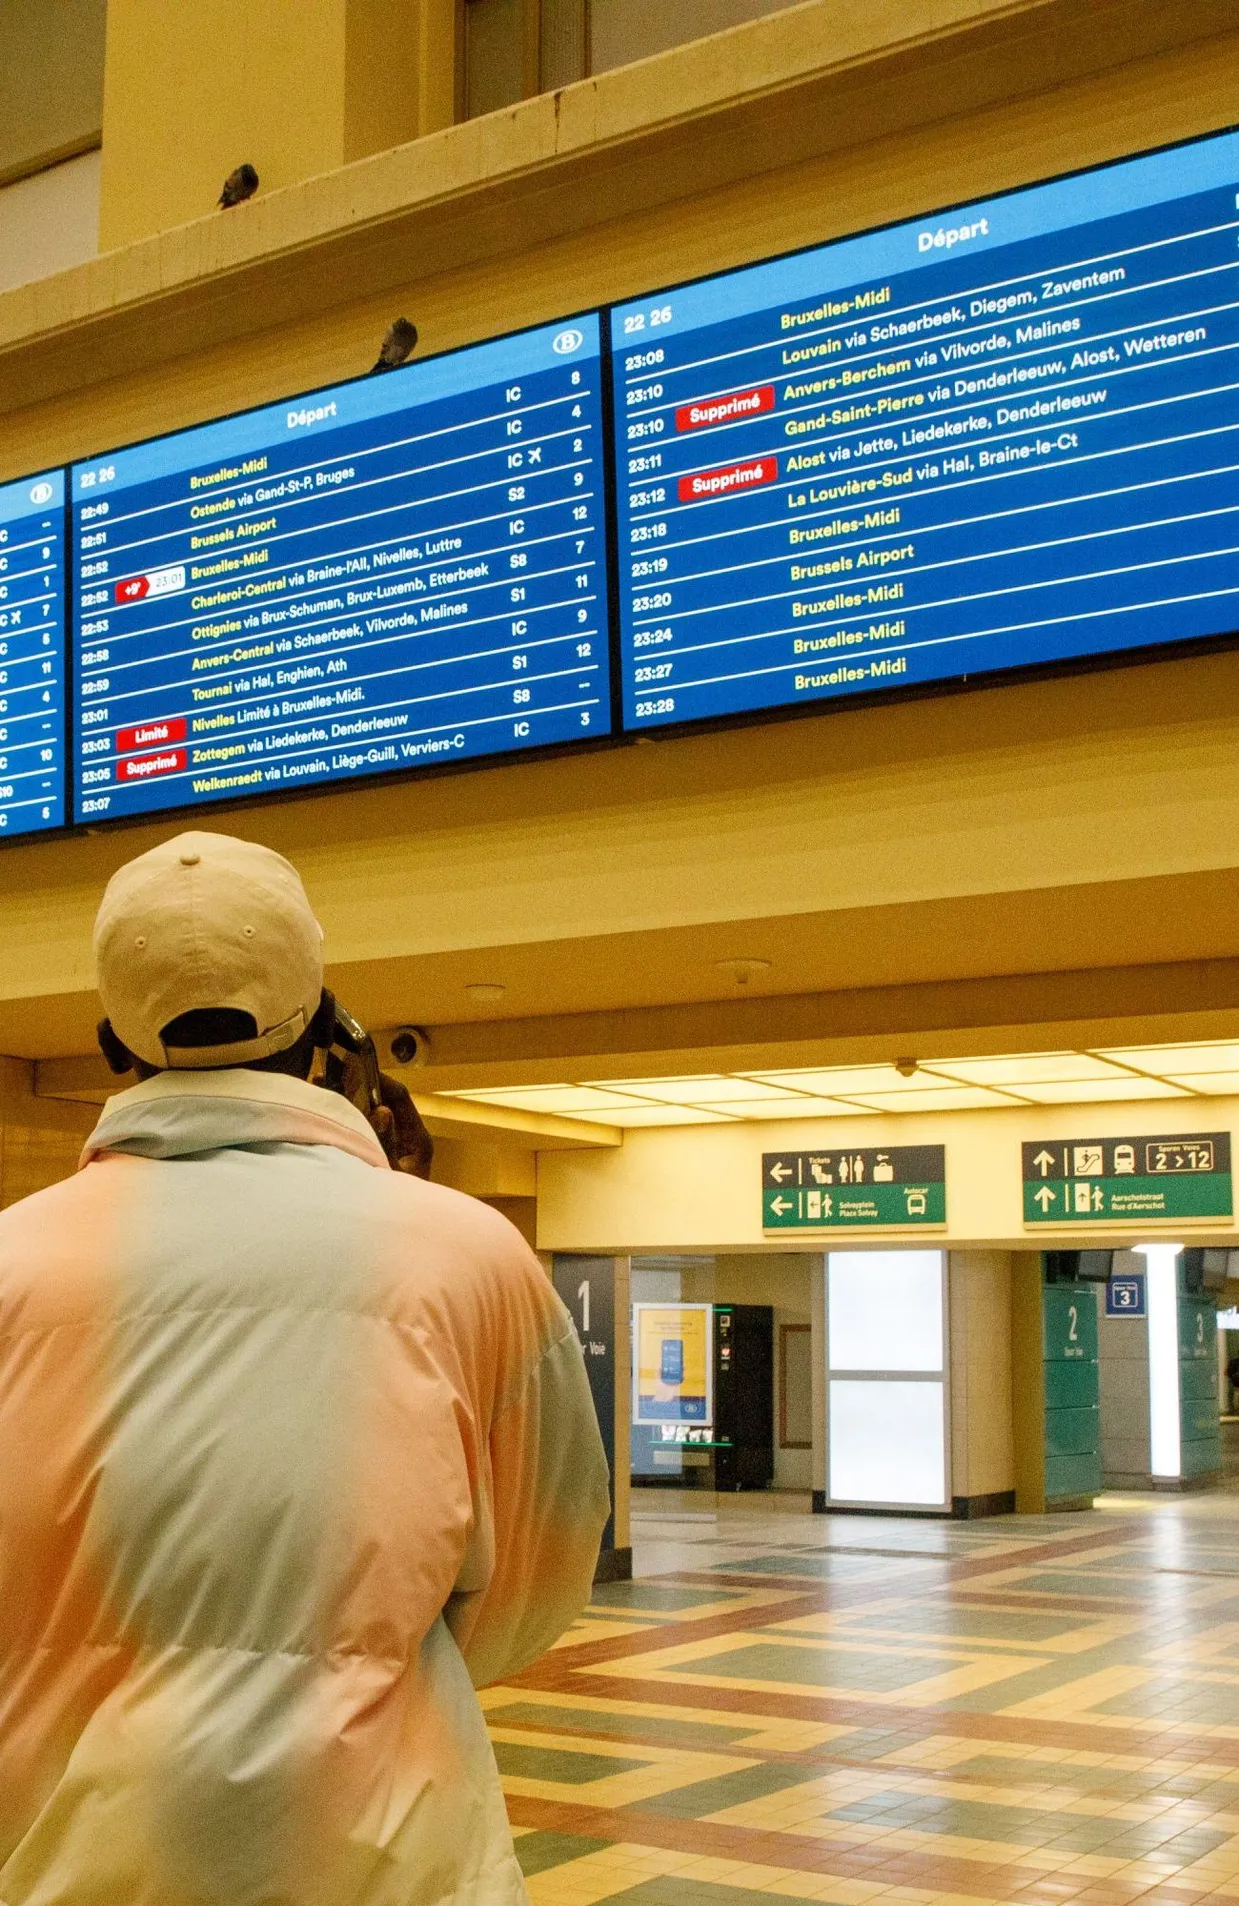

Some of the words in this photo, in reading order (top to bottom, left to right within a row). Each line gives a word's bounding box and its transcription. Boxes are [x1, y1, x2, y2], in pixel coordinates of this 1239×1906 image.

[624, 314, 645, 333] 22
[650, 305, 672, 326] 26
[918, 218, 988, 252] Départ
[625, 348, 664, 371] 23:08
[780, 286, 890, 329] Bruxelles-Midi
[626, 384, 663, 405] 23:10
[782, 338, 841, 364] Louvain
[844, 331, 867, 348] via
[870, 306, 966, 342] Schaerbeek,
[970, 291, 1037, 317] Diegem,
[1042, 267, 1125, 299] Zaventem
[627, 418, 664, 439] 23:10
[690, 393, 760, 423] Supprimé
[784, 359, 911, 400] Anvers-Berchem
[915, 351, 937, 367] via
[940, 334, 1011, 361] Vilvorde,
[1016, 318, 1080, 343] Malines
[628, 453, 661, 473] 23:11
[785, 393, 924, 435] Gand-Saint-Pierre
[927, 385, 950, 402] via
[954, 361, 1066, 396] Denderleeuw,
[1070, 346, 1119, 369] Alost,
[1123, 327, 1206, 356] Wetteren
[80, 472, 96, 488] 22
[99, 466, 115, 482] 26
[287, 402, 336, 428] Départ
[80, 502, 109, 520] 22:49
[190, 456, 267, 489] Bruxelles-Midi
[506, 386, 521, 402] IC
[571, 370, 580, 384] 8
[80, 531, 106, 548] 22:51
[190, 497, 236, 518] Ostende
[237, 492, 253, 506] via
[255, 475, 313, 501] Gand-St-P,
[315, 467, 355, 486] Bruges
[507, 419, 522, 435] IC
[571, 404, 581, 417] 4
[629, 487, 665, 508] 23:12
[692, 464, 763, 493] Supprimé
[786, 451, 825, 472] Alost
[828, 445, 850, 462] via
[853, 438, 898, 456] Jette,
[902, 416, 992, 446] Liedekerke,
[996, 389, 1106, 425] Denderleeuw
[630, 522, 666, 542] 23:18
[788, 493, 806, 508] La
[809, 467, 913, 503] Louvière-Sud
[916, 463, 939, 480] via
[943, 455, 974, 474] Hal,
[979, 433, 1078, 467] Braine-le-Ct
[81, 560, 108, 578] 22:52
[190, 528, 234, 549] Brussels
[236, 517, 276, 537] Airport
[507, 452, 522, 468] IC
[573, 438, 582, 452] 2
[81, 590, 108, 607] 22:52
[156, 573, 181, 587] 23:01
[191, 548, 268, 579] Bruxelles-Midi
[508, 486, 525, 501] S2
[574, 472, 583, 486] 9
[631, 557, 668, 577] 23:19
[789, 507, 900, 544] Bruxelles-Midi
[42, 603, 50, 616] 7
[43, 575, 49, 587] 1
[81, 619, 108, 636] 22:53
[191, 576, 286, 609] Charleroi-Central
[288, 572, 304, 586] via
[307, 556, 370, 582] Braine-l'All,
[373, 547, 422, 567] Nivelles,
[425, 538, 462, 555] Luttre
[509, 519, 524, 535] IC
[572, 505, 587, 520] 12
[81, 648, 109, 665] 22:58
[191, 620, 241, 639] Ottignies
[243, 615, 259, 628] via
[261, 598, 344, 624] Brux-Schuman,
[346, 577, 426, 605] Brux-Luxemb,
[429, 562, 488, 587] Etterbeek
[510, 553, 527, 568] S8
[575, 540, 584, 553] 7
[632, 592, 671, 612] 23:20
[790, 556, 853, 580] Brussels
[856, 544, 914, 567] Airport
[81, 678, 109, 695] 22:59
[191, 641, 274, 670] Anvers-Central
[275, 638, 292, 652] via
[294, 623, 363, 648] Schaerbeek,
[365, 612, 417, 633] Vilvorde,
[420, 603, 468, 622] Malines
[510, 587, 525, 602] S1
[575, 574, 587, 588] 11
[633, 627, 672, 647] 23:24
[792, 582, 903, 617] Bruxelles-Midi
[634, 663, 673, 682] 23:27
[793, 620, 905, 653] Bruxelles-Midi
[41, 661, 51, 673] 11
[42, 690, 50, 702] 4
[81, 708, 108, 724] 23:01
[191, 681, 232, 700] Tournai
[234, 678, 250, 692] via
[252, 673, 274, 689] Hal,
[276, 665, 324, 684] Enghien,
[326, 658, 347, 673] Ath
[512, 620, 527, 636] IC
[577, 609, 587, 622] 9
[81, 737, 110, 754] 23:03
[135, 725, 168, 743] Limité
[192, 714, 235, 732] Nivelles
[237, 705, 270, 723] Limité
[272, 704, 279, 716] à
[282, 687, 364, 714] Bruxelles-Midi.
[512, 655, 527, 669] S1
[576, 642, 591, 657] 12
[635, 698, 674, 716] 23:28
[795, 657, 906, 689] Bruxelles-Midi
[82, 796, 110, 813] 23:07
[192, 769, 262, 792] Welkenraedt
[264, 767, 280, 780] via
[283, 758, 329, 777] Louvain,
[332, 745, 398, 769] Liège-Guill,
[401, 733, 464, 756] Verviers-C
[514, 721, 529, 737] IC
[580, 712, 589, 725] 3
[126, 754, 177, 775] Supprimé
[192, 744, 245, 763] Zottegem
[247, 738, 263, 752] via
[265, 728, 328, 749] Liedekerke,
[331, 714, 408, 737] Denderleeuw
[513, 688, 530, 703] S8
[1155, 1153, 1167, 1170] 2
[1188, 1151, 1210, 1169] 12
[839, 1209, 857, 1217] Place
[858, 1209, 878, 1217] Solvay
[578, 1280, 590, 1331] 1
[1069, 1306, 1078, 1341] 2
[1120, 1291, 1131, 1305] 3
[589, 1341, 606, 1355] Voie
